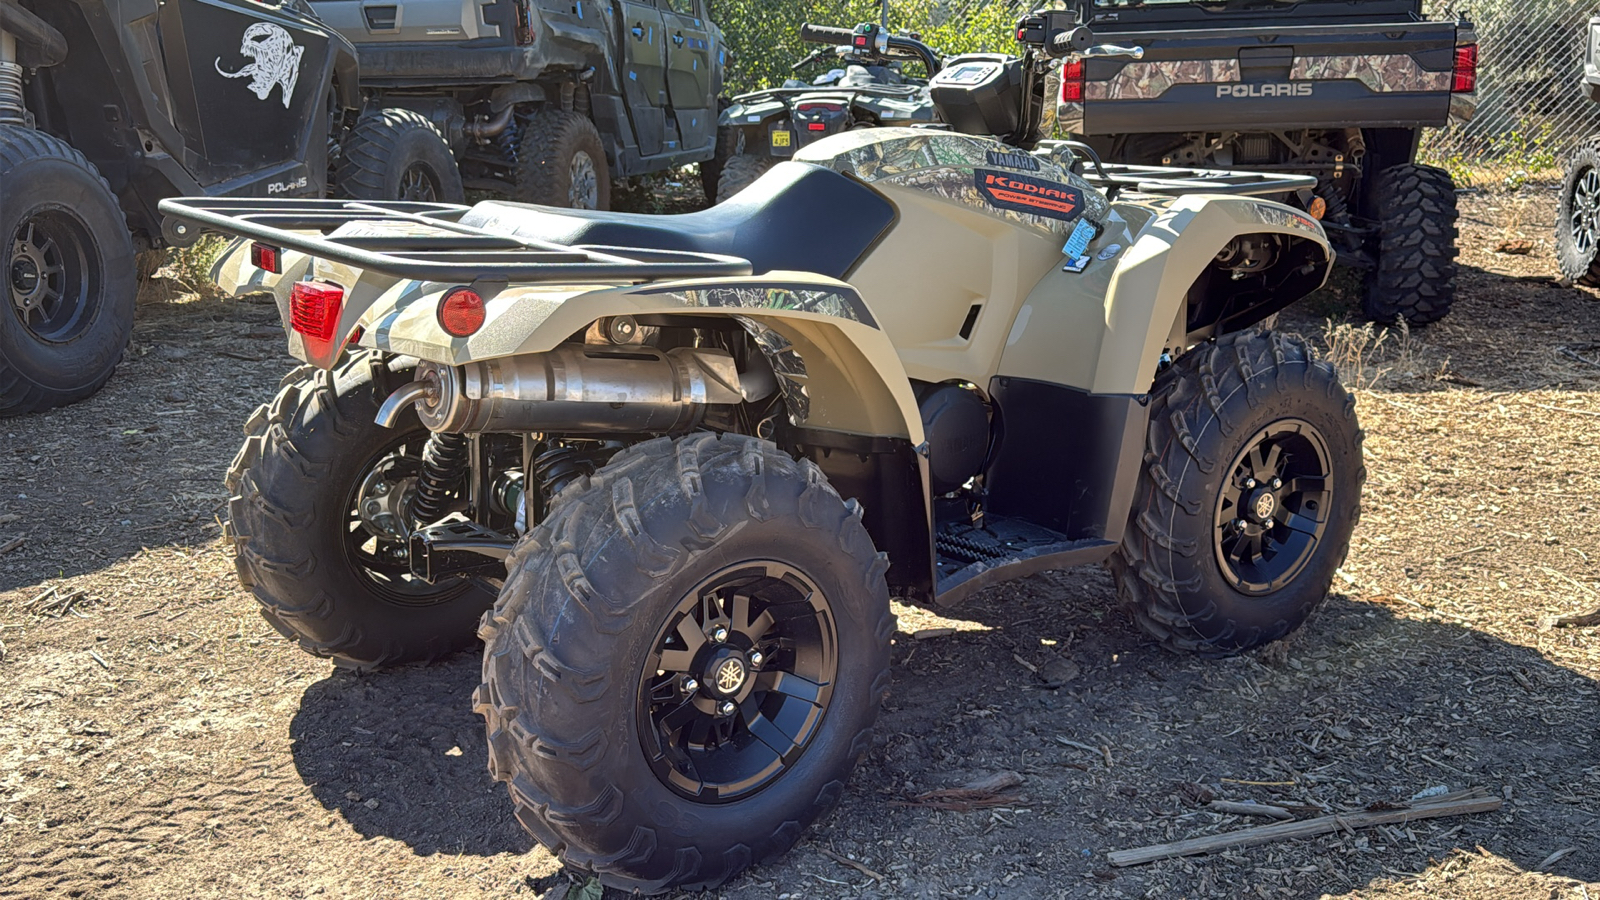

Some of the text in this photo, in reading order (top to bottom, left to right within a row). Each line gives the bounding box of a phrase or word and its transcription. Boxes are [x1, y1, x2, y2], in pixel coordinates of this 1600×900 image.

[1216, 83, 1313, 98] POLARIS
[991, 152, 1036, 170] YAMAHA
[985, 174, 1076, 202] KODIAK
[998, 192, 1066, 210] POWER STEERING
